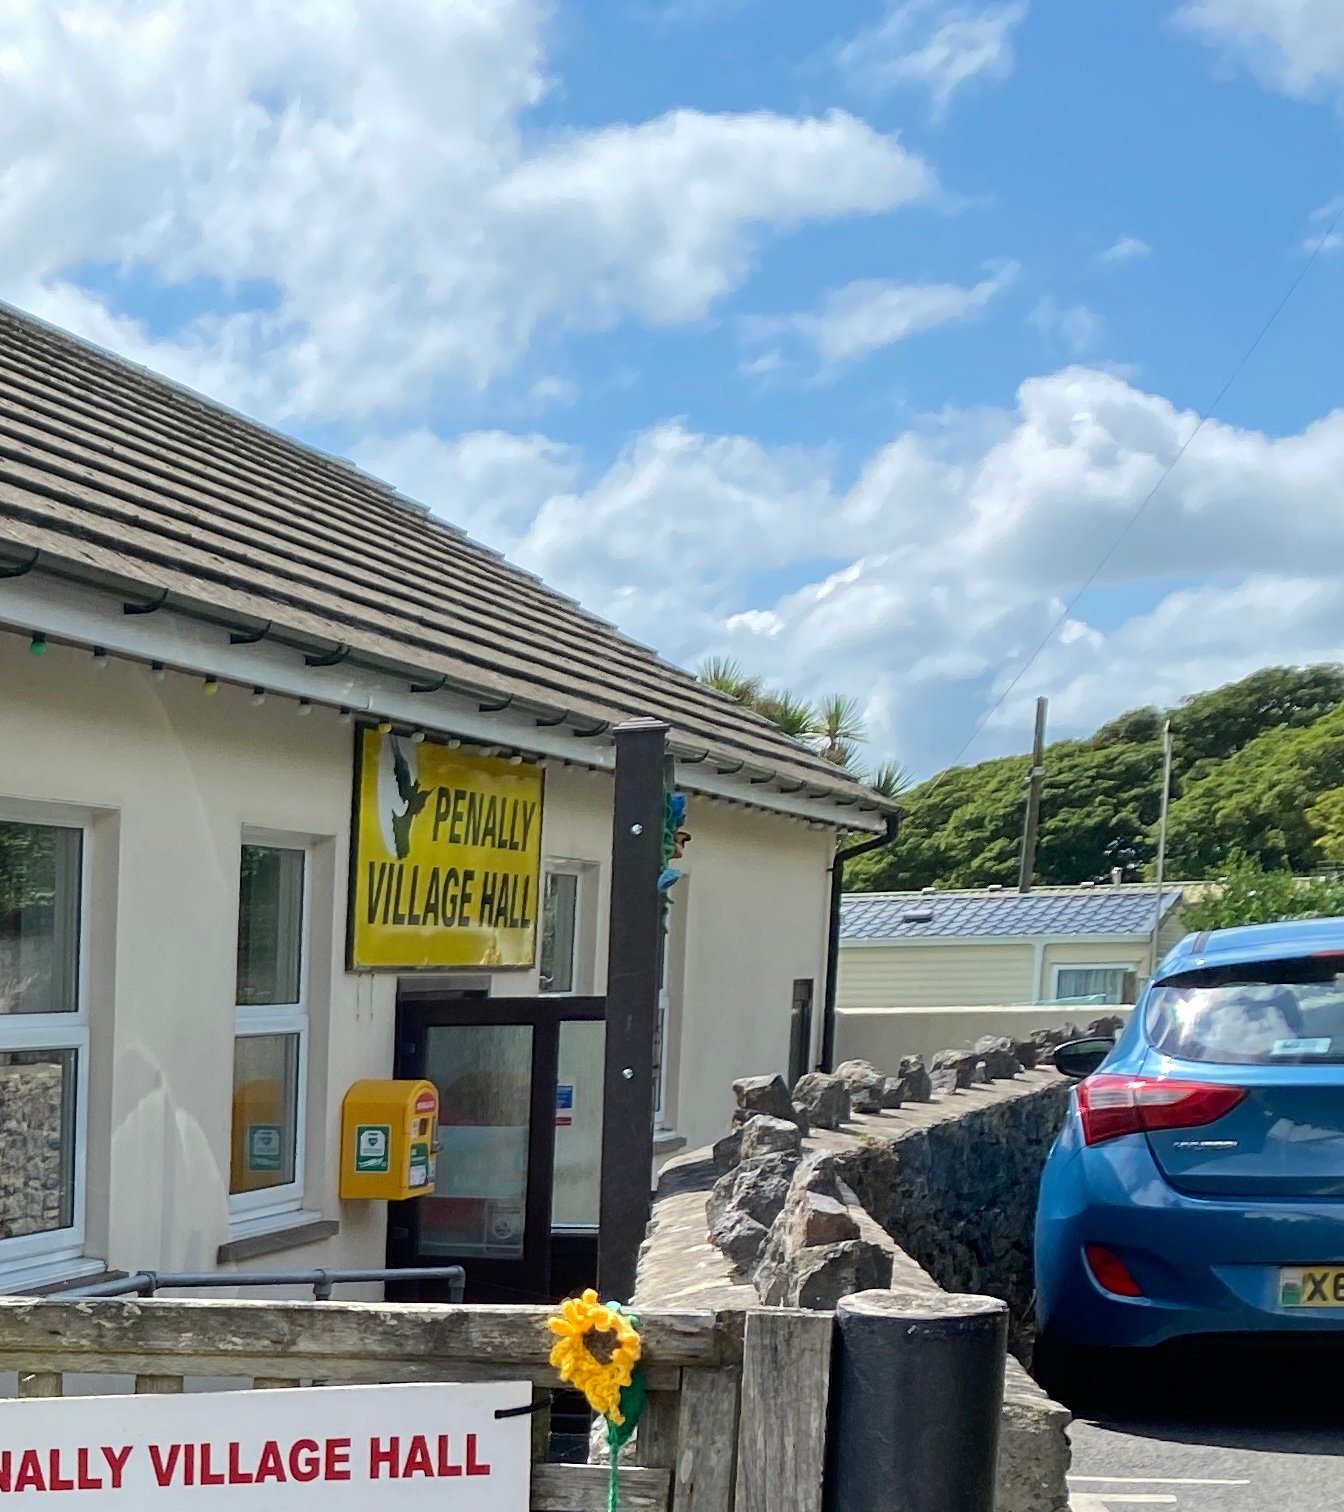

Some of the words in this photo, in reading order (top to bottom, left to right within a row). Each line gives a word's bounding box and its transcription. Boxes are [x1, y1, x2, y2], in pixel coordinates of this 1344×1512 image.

[432, 786, 536, 852] PENALLY
[367, 861, 475, 927] VILLAGE
[479, 871, 531, 929] HALL
[148, 1438, 351, 1487] VILLAGE
[369, 1434, 490, 1479] HALL
